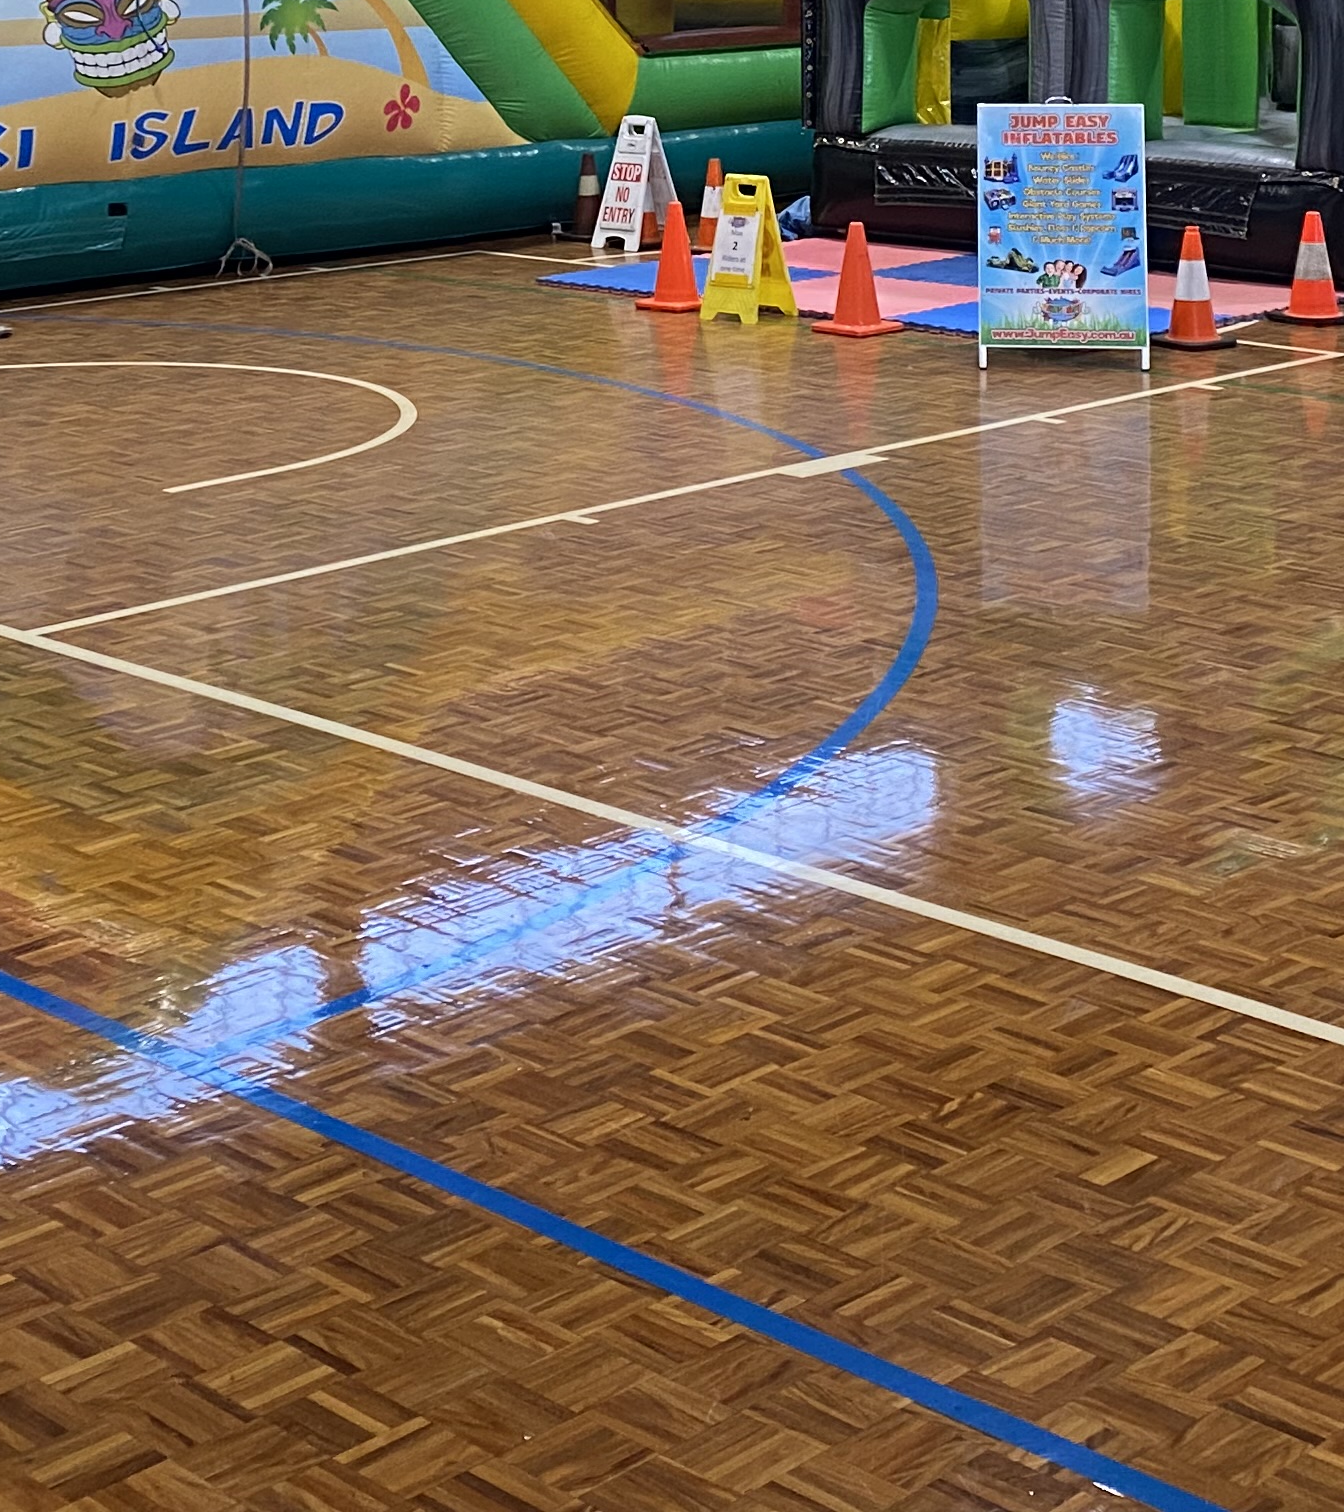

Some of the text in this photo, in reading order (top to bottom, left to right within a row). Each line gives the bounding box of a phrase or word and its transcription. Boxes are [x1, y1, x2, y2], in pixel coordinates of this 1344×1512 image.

[1010, 114, 1109, 128] JUMP EASY
[109, 101, 345, 161] ISLAND
[1003, 131, 1118, 144] INFLATABLES
[612, 163, 642, 181] STOP
[616, 186, 630, 202] NO
[602, 206, 635, 224] ENTRY
[732, 241, 738, 251] 2
[992, 328, 1135, 342] www.JumpEasy.com.au
